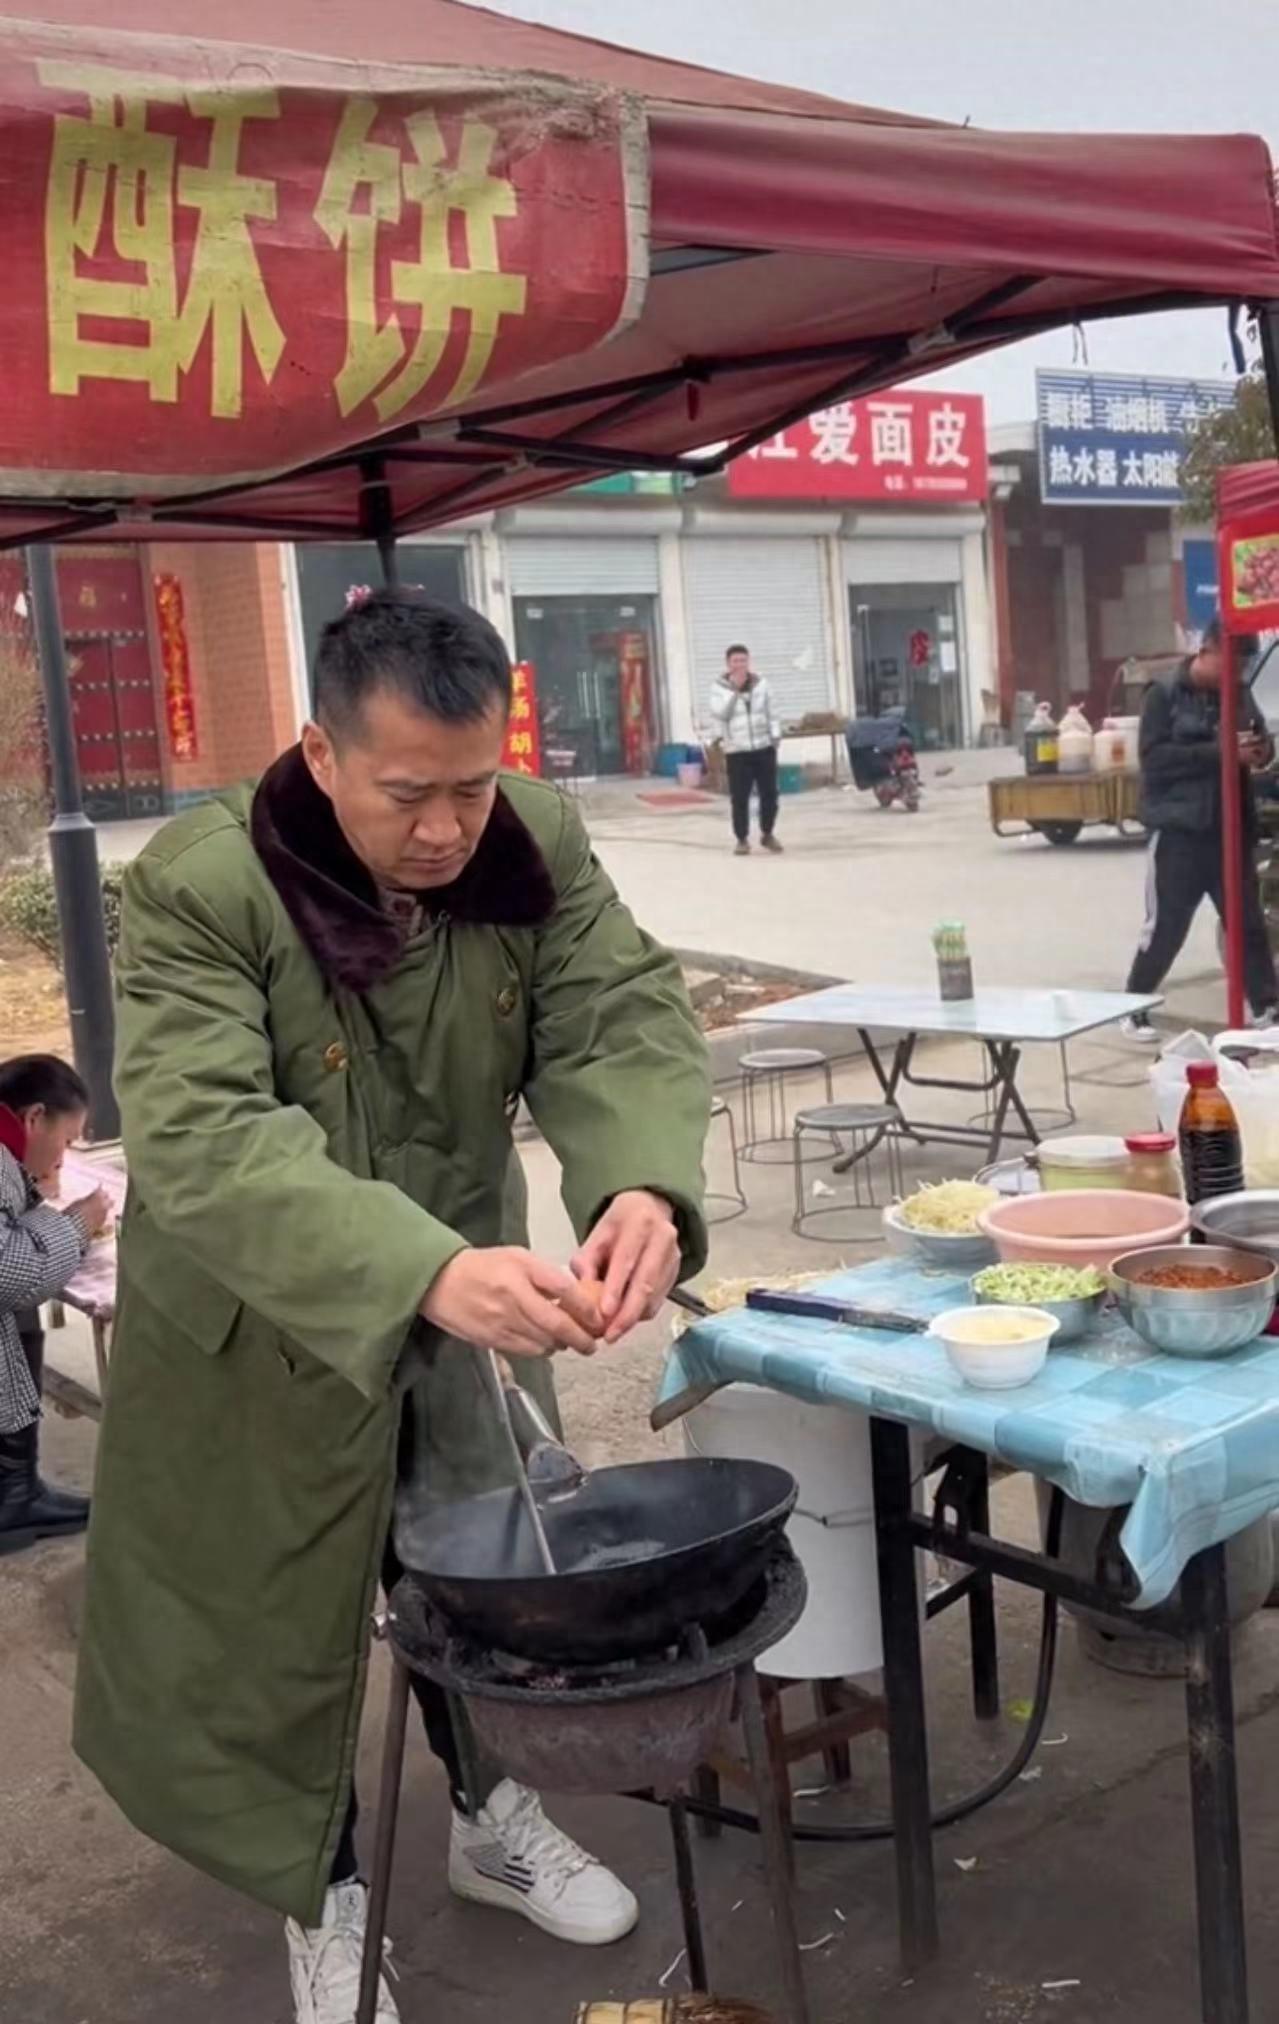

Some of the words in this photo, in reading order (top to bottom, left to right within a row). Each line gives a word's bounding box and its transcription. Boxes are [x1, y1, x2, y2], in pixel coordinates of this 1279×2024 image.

[36, 60, 527, 422] 酥饼
[1050, 446, 1117, 486] 热水器
